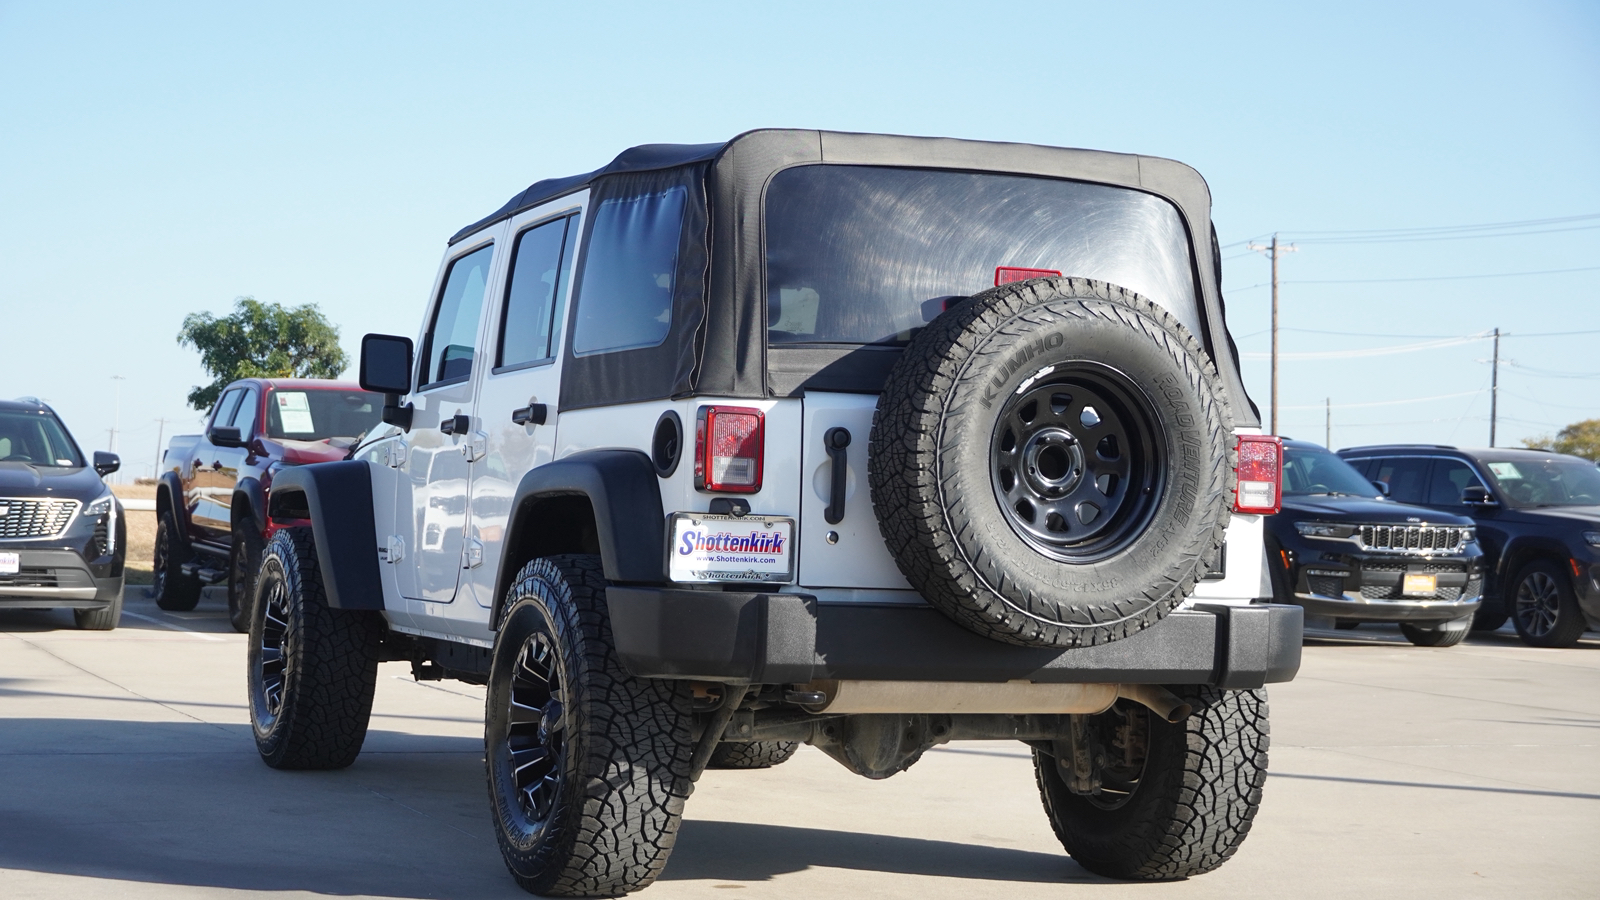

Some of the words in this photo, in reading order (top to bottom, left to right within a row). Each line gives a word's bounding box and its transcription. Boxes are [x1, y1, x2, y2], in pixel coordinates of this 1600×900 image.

[979, 331, 1064, 409] KUMHO
[679, 530, 785, 555] Shottenkirk
[696, 555, 776, 564] www.Shottenkirk.com
[697, 570, 763, 580] Shottenkirk
